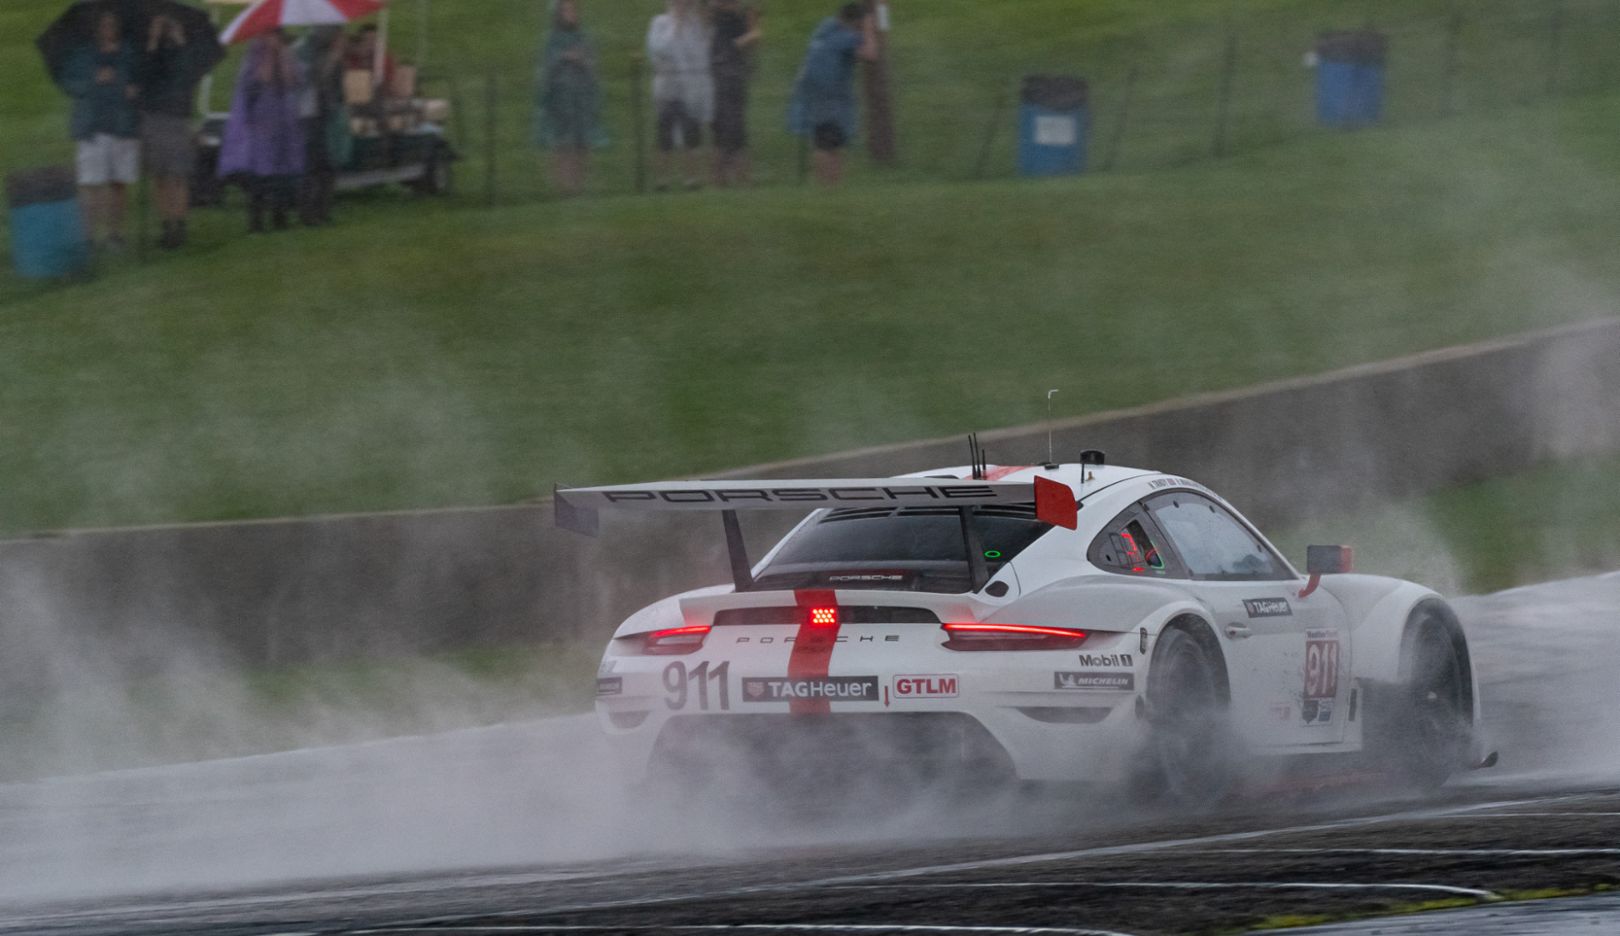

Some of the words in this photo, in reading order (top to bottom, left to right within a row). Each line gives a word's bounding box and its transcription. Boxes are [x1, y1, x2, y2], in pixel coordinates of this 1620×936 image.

[603, 486, 997, 502] PORSCHE
[736, 635, 900, 644] PORCHE
[1079, 654, 1119, 667] Mobil
[1122, 654, 1132, 667] 1
[662, 660, 730, 711] 911
[768, 681, 872, 697] TAGHeuer
[896, 678, 957, 695] GTLM
[1078, 677, 1129, 685] MICHELIN
